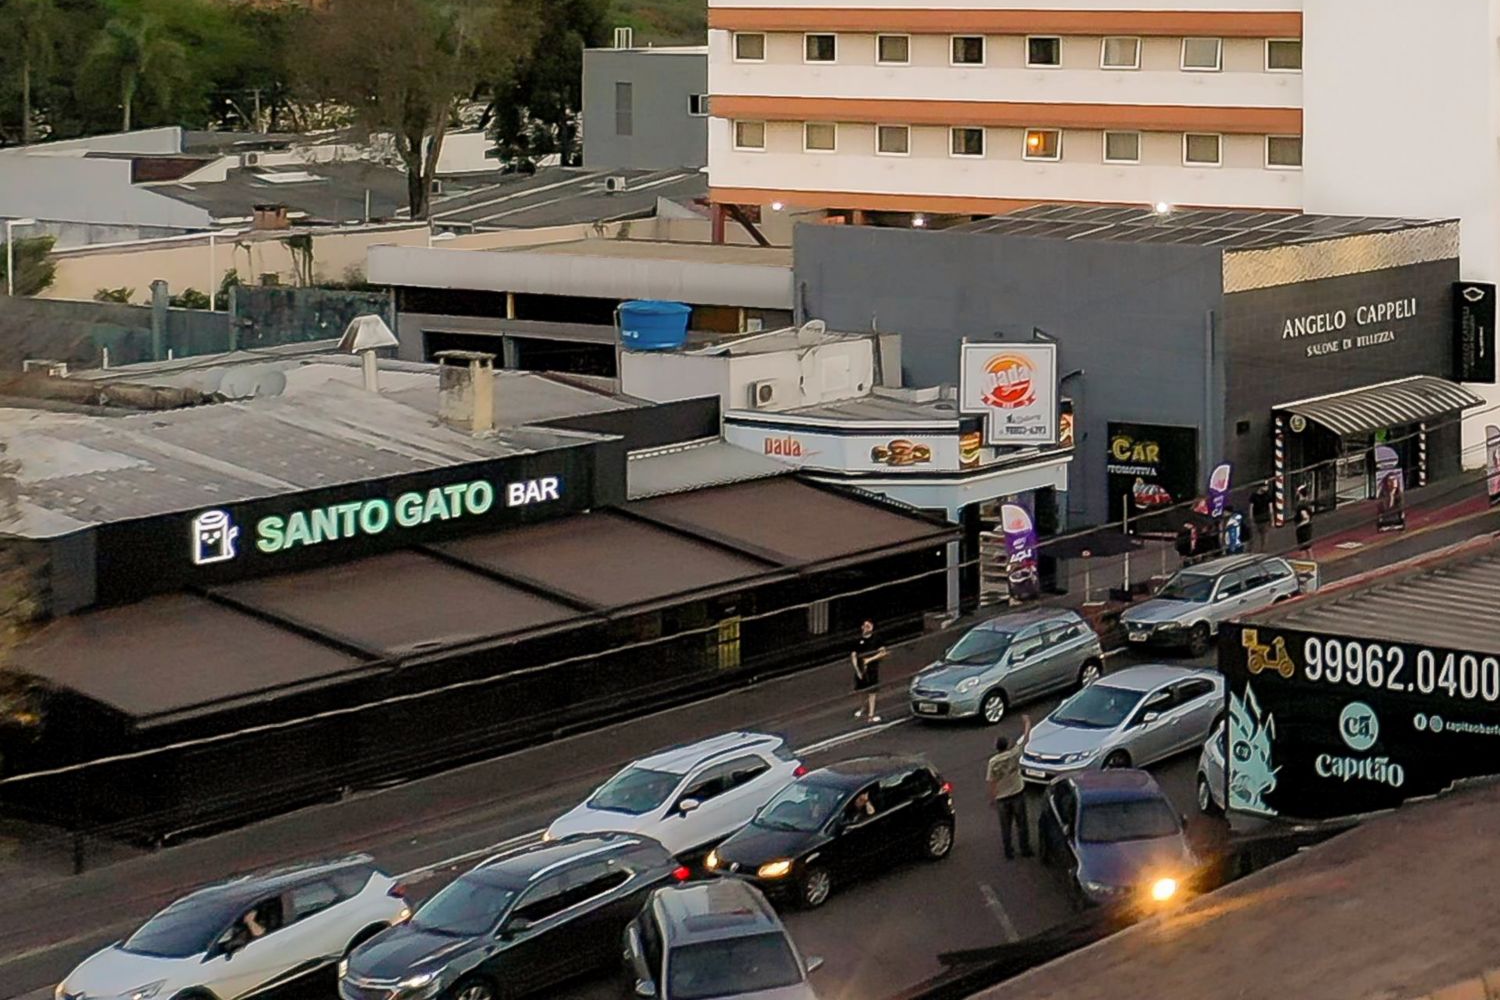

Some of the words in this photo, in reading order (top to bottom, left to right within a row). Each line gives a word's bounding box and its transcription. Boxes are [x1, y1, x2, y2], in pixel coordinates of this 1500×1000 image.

[1282, 310, 1347, 339] ANGELO
[1356, 298, 1417, 325] CAPPELI
[257, 500, 389, 552] SANTO
[395, 480, 493, 527] GATO
[507, 476, 559, 507] BAR
[1304, 637, 1500, 701] 99962.0400
